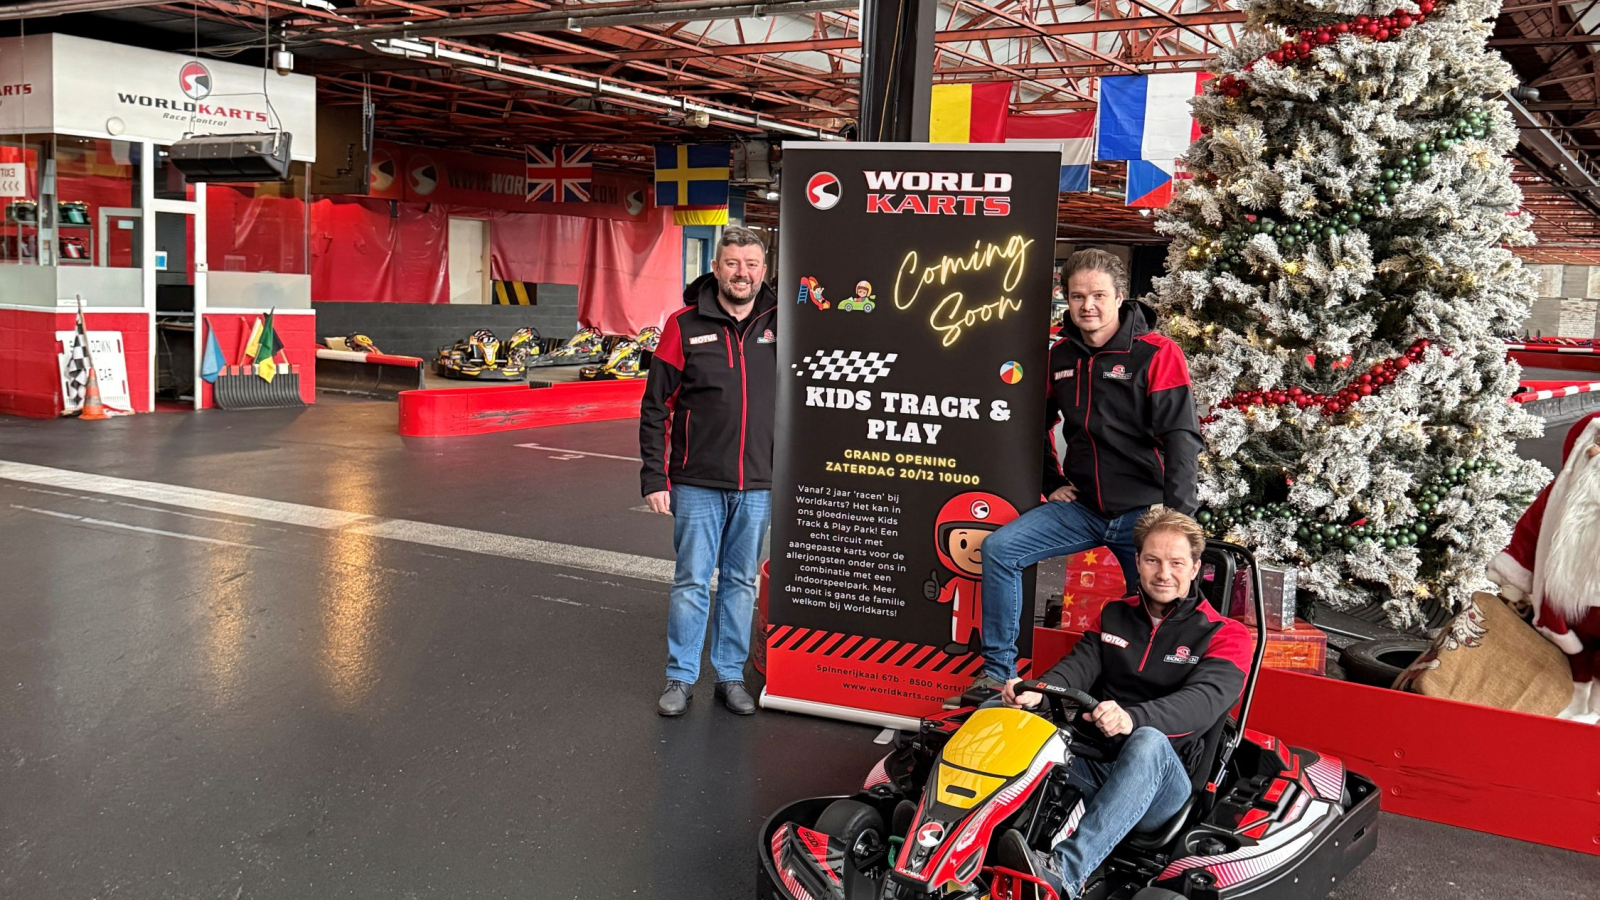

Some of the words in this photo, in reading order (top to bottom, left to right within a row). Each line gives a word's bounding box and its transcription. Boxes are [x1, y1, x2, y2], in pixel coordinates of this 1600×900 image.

[0, 84, 31, 96] RTS
[118, 92, 267, 122] WORLDKARTS
[162, 112, 186, 122] Race
[191, 116, 228, 127] Control
[863, 170, 1012, 192] WORLD
[866, 193, 1011, 216] KARTS
[894, 234, 1035, 310] Coming
[929, 291, 1022, 347] Soon
[806, 386, 872, 411] KIDS
[880, 392, 980, 420] TRACK
[989, 400, 1011, 421] &
[866, 418, 942, 445] PLAY
[844, 449, 891, 463] GRAND
[895, 453, 956, 468] OPENING
[825, 461, 896, 478] ZATERDAG
[899, 468, 934, 482] 20/12
[938, 472, 980, 486] 10U00
[798, 485, 824, 494] Vanaf
[833, 489, 851, 497] jaar
[888, 494, 899, 504] bij
[796, 496, 850, 508] Worldkarts?
[853, 502, 869, 511] Het
[872, 504, 889, 512] kan
[892, 505, 901, 514] in
[797, 518, 820, 528] Track
[832, 523, 851, 532] Play
[854, 525, 878, 534] Park!
[881, 528, 898, 536] Een
[816, 510, 875, 522] gloednieuwe
[878, 516, 898, 525] Kids
[810, 532, 829, 540] echt
[832, 534, 861, 544] circuit
[865, 538, 883, 546] met
[789, 541, 840, 553] aangepaste
[844, 547, 866, 556] karts
[892, 552, 904, 560] de
[786, 552, 845, 564] allerjongsten
[848, 559, 875, 568] onder
[878, 563, 894, 571] ons
[898, 564, 906, 572] in
[800, 564, 850, 577] combinatie
[853, 571, 871, 580] met
[874, 574, 891, 582] een
[794, 574, 870, 591] indoorspeelpark.
[873, 584, 896, 594] Meer
[785, 584, 802, 593] dan
[805, 588, 822, 596] ooit
[825, 589, 832, 597] is
[834, 591, 856, 600] gans
[859, 594, 870, 602] de
[873, 596, 905, 606] familie
[792, 597, 826, 608] welkom
[829, 601, 841, 611] bij
[844, 603, 897, 616] Worldkarts!
[816, 664, 879, 681] Spinnerijkaai
[882, 673, 900, 683] 67b
[908, 677, 933, 688] 8500
[936, 682, 968, 693] Kortri
[843, 682, 945, 703] www.worldkarts.com
